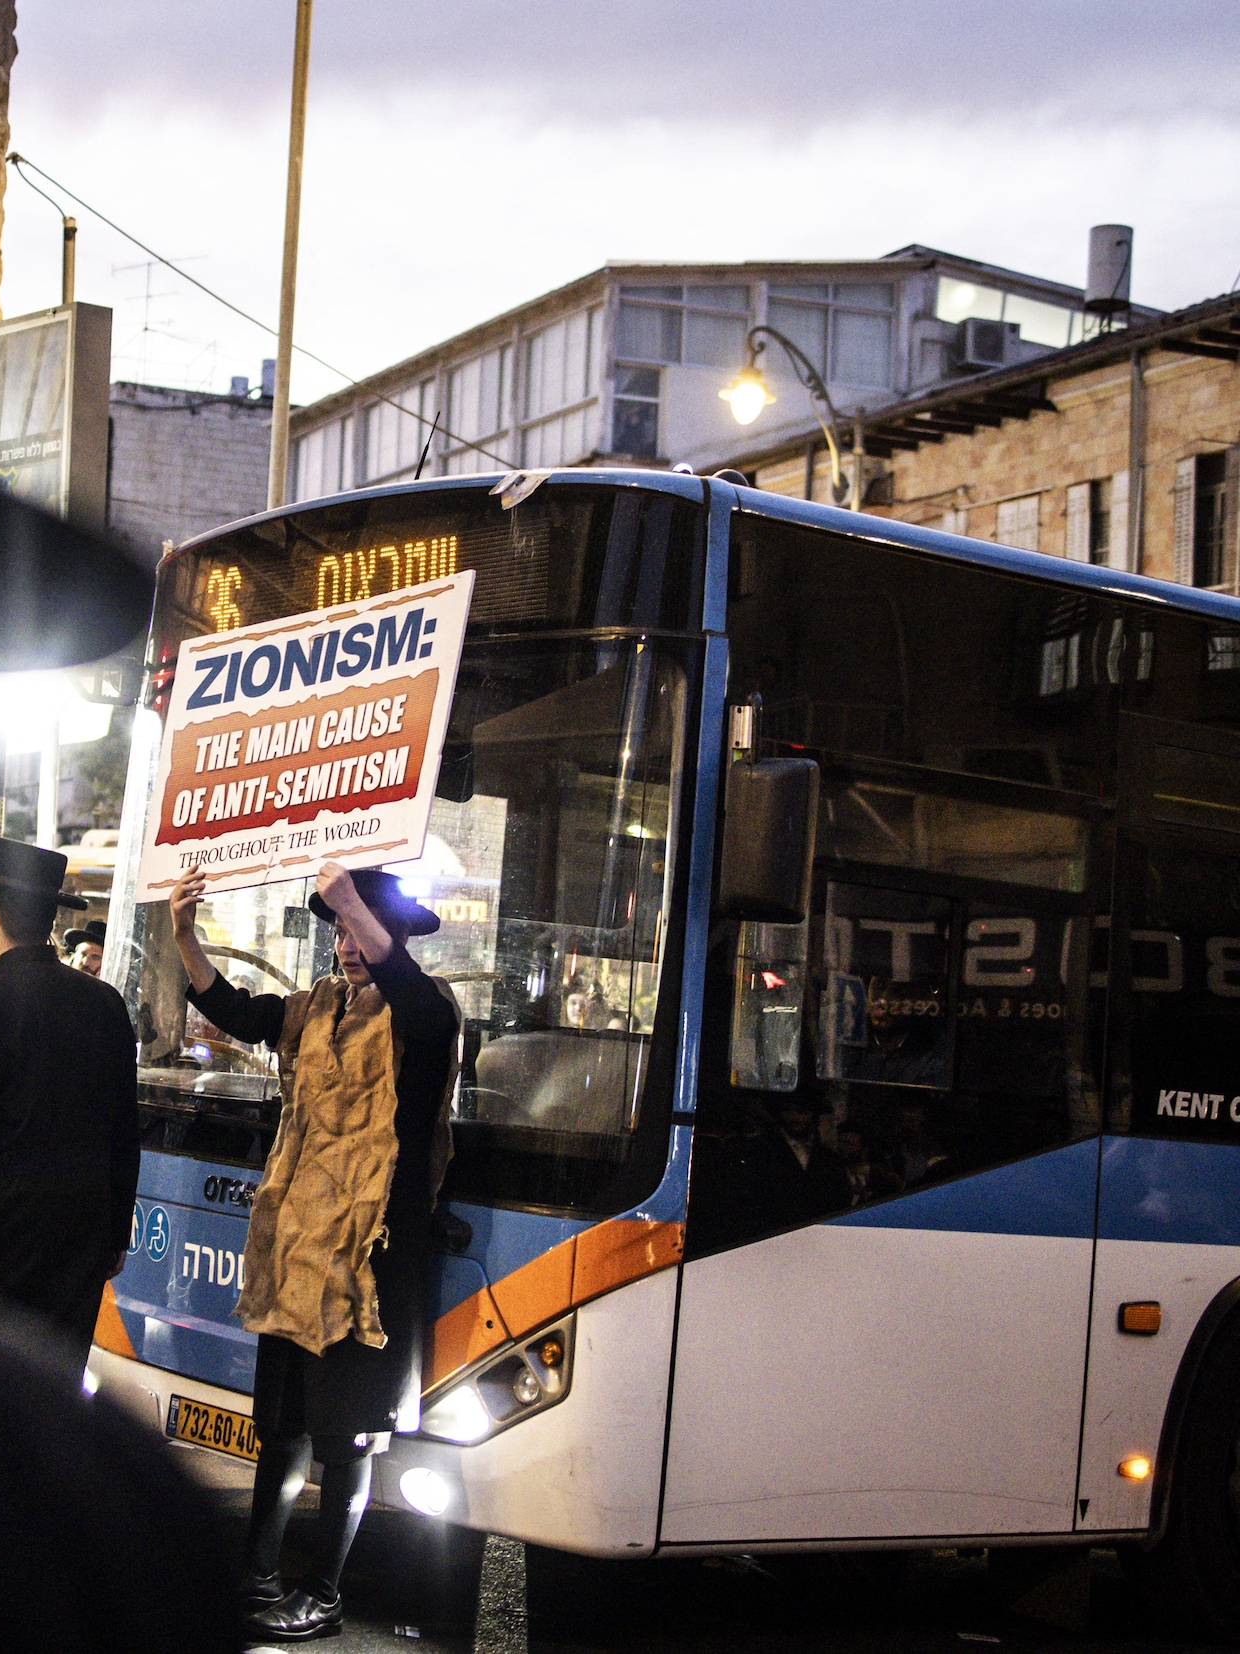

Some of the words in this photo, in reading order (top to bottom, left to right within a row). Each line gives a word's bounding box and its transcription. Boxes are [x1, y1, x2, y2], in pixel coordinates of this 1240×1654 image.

[185, 607, 438, 711] ZIONISM:
[194, 735, 243, 774] THE
[244, 719, 314, 762] MAIN
[317, 693, 408, 750] CAUSE
[171, 788, 205, 829] OF
[206, 745, 410, 822] ANTI-SEMITISM
[179, 836, 286, 869] THROUGHOUT
[287, 829, 318, 849] THE
[324, 817, 381, 843] WORLD
[1156, 1089, 1225, 1120] KENT
